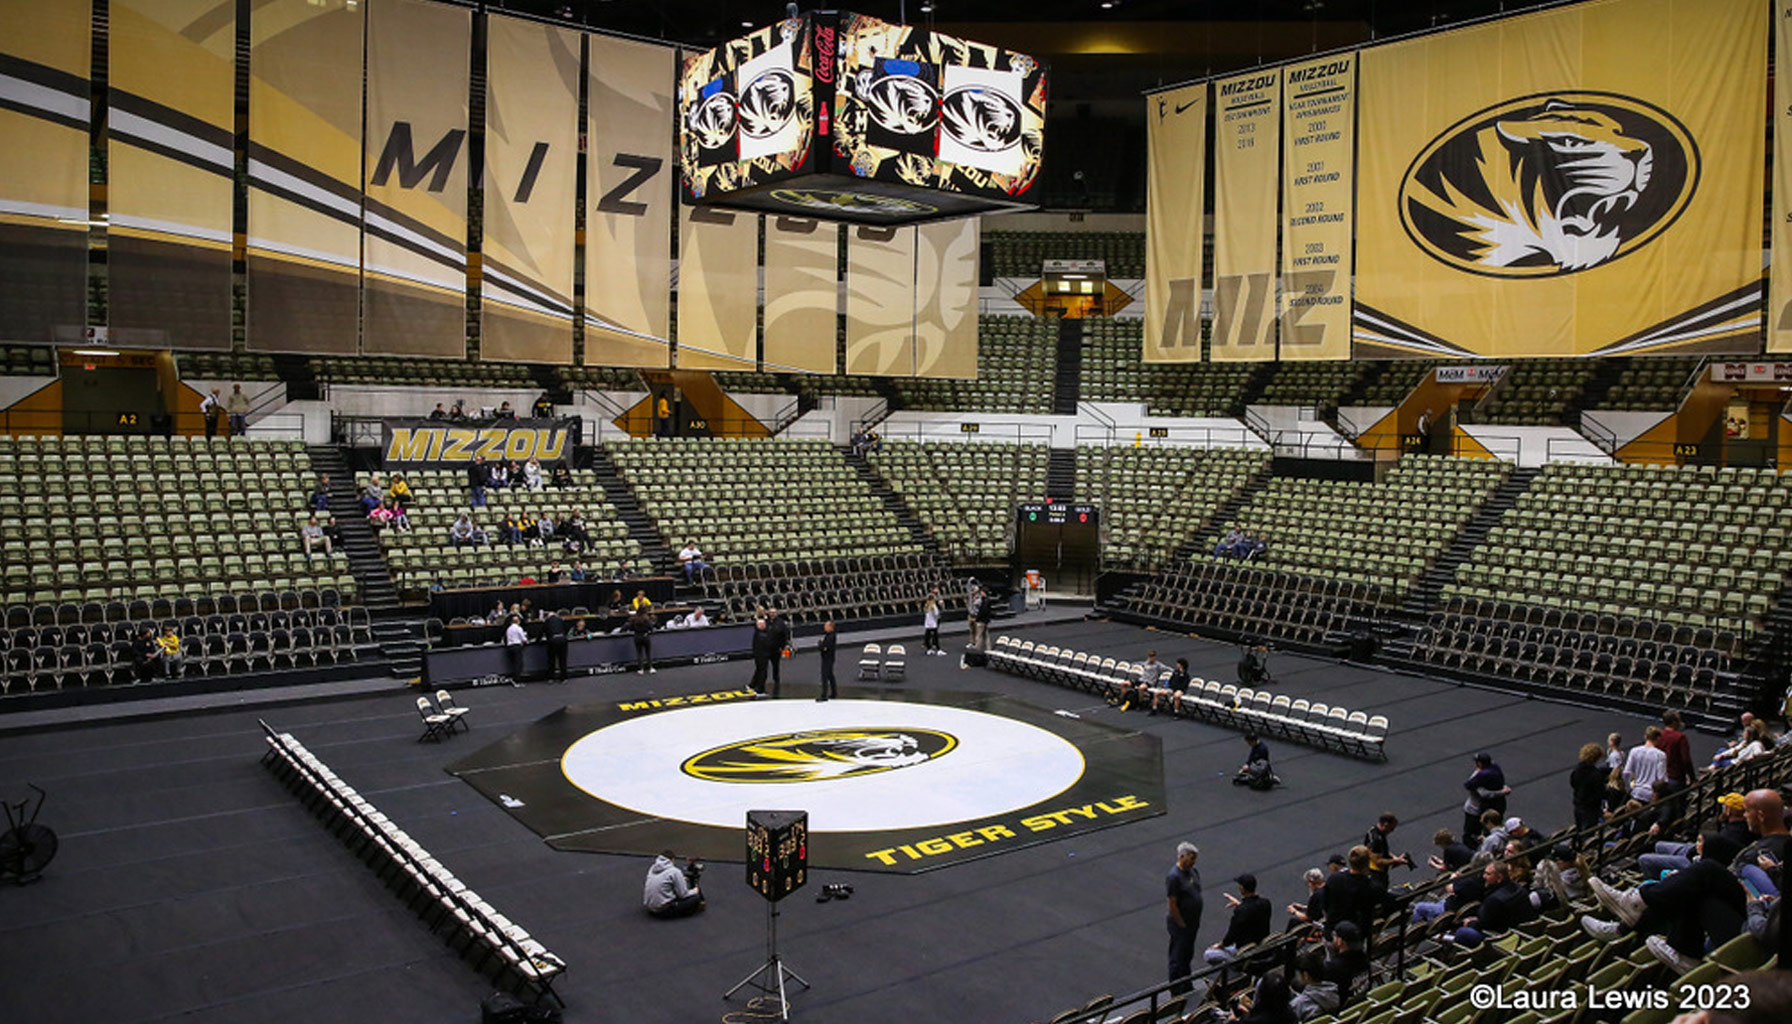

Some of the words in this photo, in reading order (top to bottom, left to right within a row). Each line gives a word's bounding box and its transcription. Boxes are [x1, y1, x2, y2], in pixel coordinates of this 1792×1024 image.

[1289, 60, 1350, 84] MIZZOU
[1220, 73, 1276, 97] MIZZOU
[1294, 135, 1314, 146] FIRST
[1315, 131, 1341, 142] ROUND
[1294, 175, 1313, 186] FIRST
[1313, 172, 1341, 184] ROUND
[1317, 212, 1345, 223] ROUND
[1293, 257, 1313, 267] FIRST
[1312, 254, 1340, 265] ROUND
[1159, 269, 1336, 348] MIZ
[1315, 295, 1344, 305] ROUND
[386, 427, 568, 462] MIZZOU
[619, 689, 755, 711] MIZZOU
[865, 825, 1016, 865] TIGER
[1021, 795, 1149, 832] STYLE
